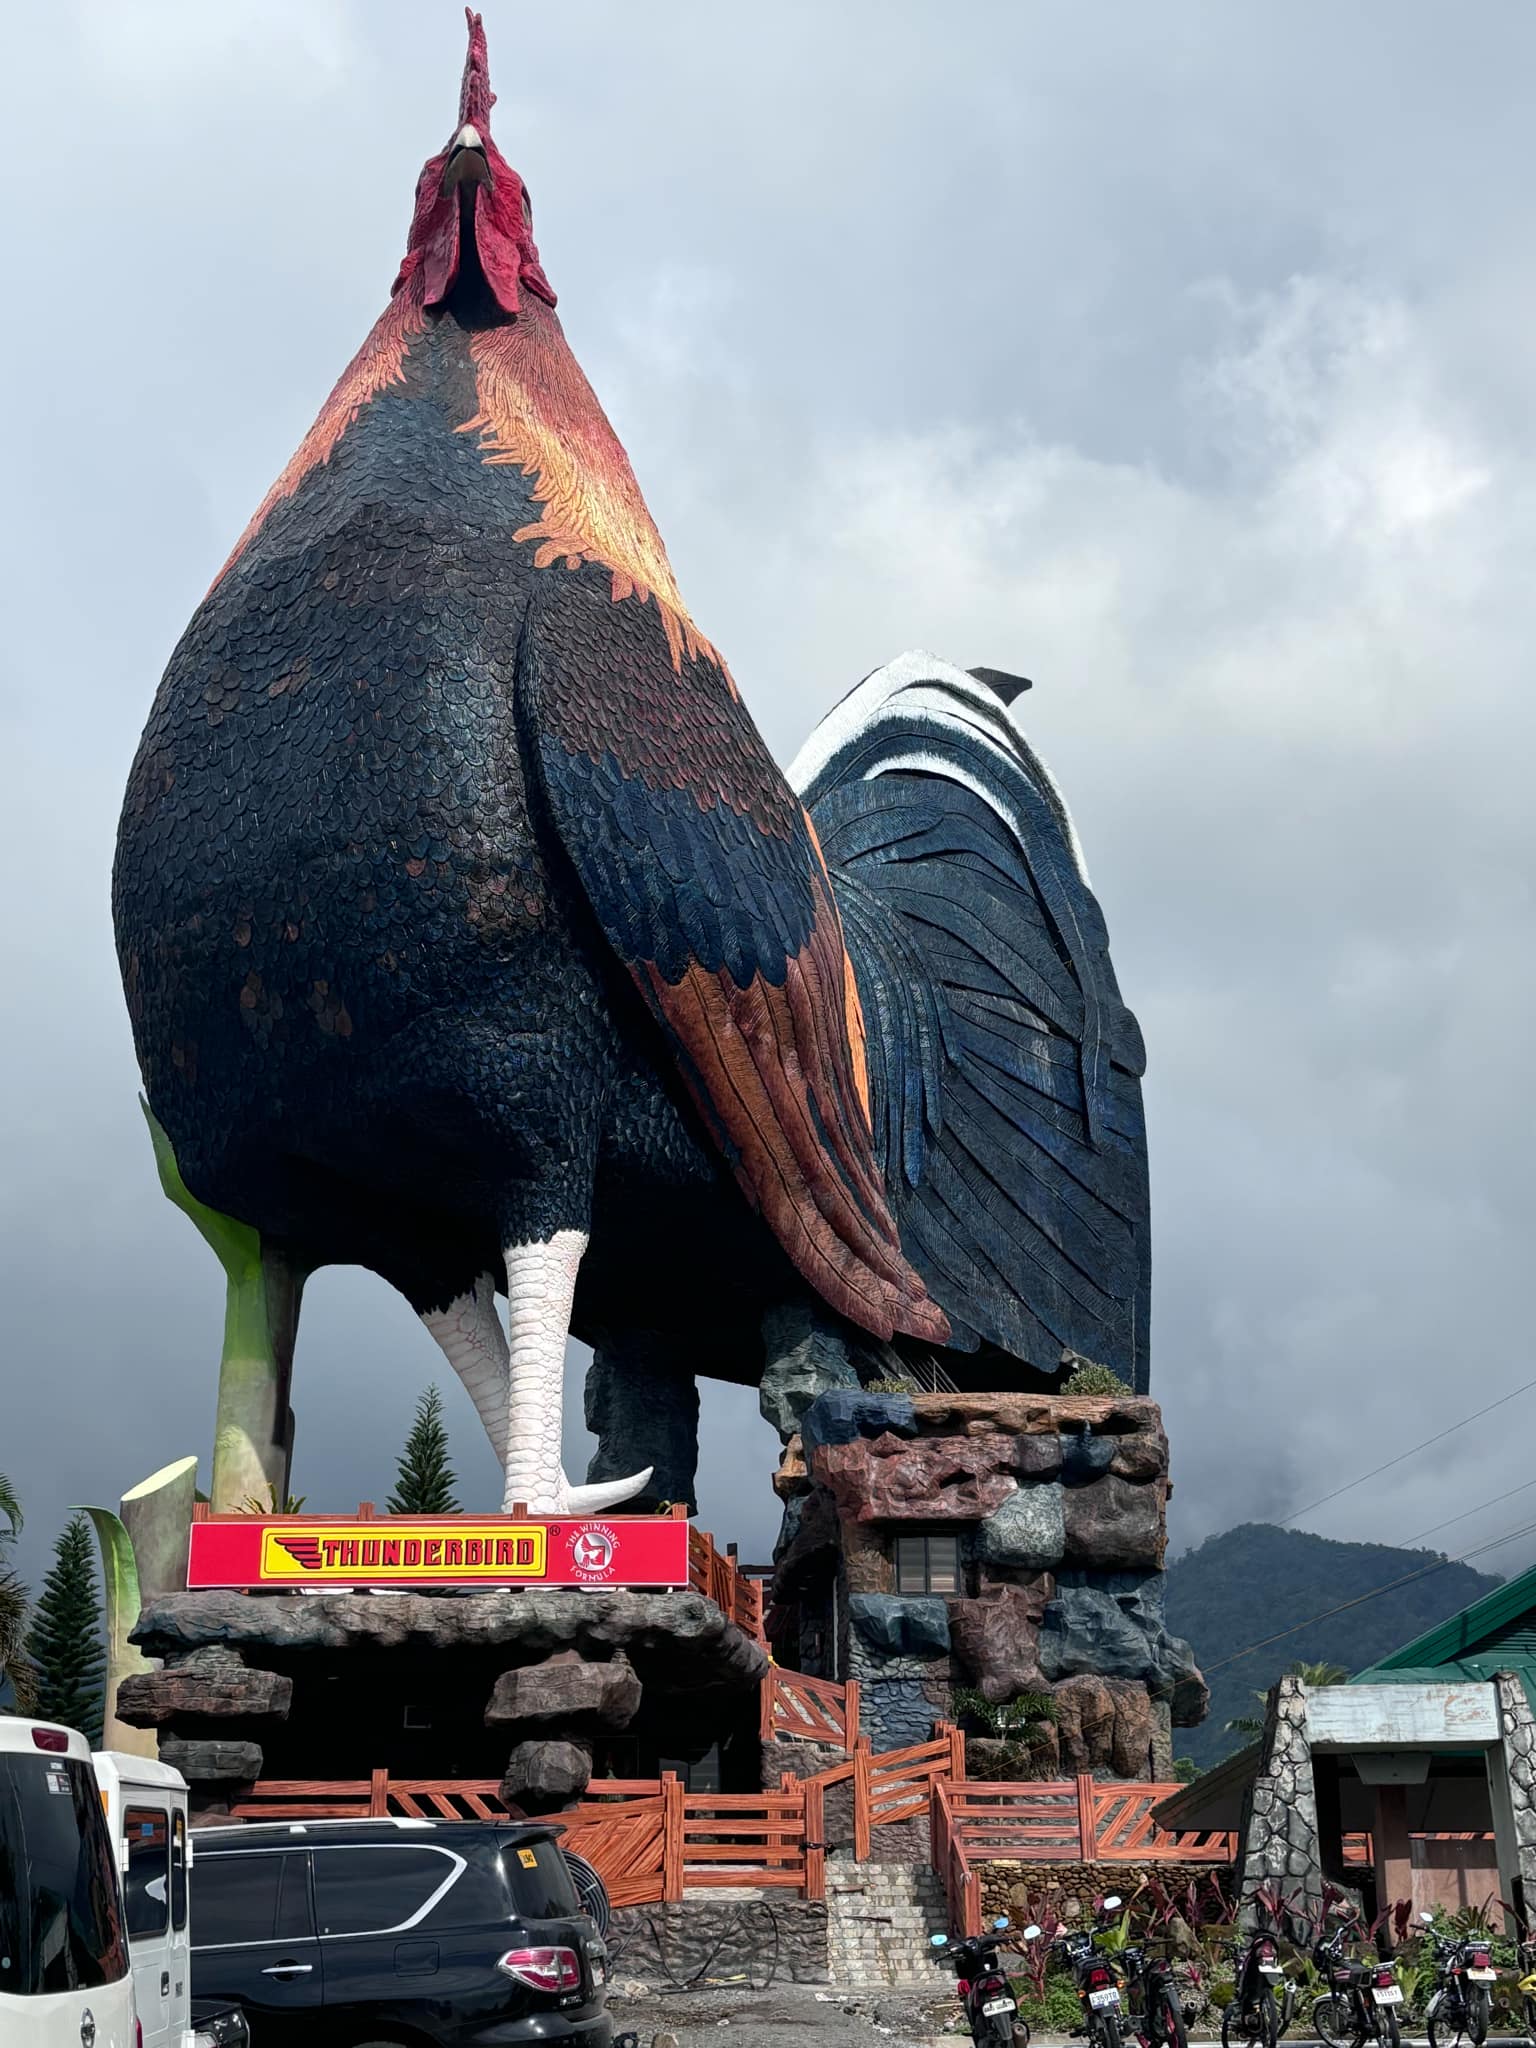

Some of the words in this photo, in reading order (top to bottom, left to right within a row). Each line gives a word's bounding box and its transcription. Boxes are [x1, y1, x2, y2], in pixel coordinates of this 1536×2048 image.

[565, 1530, 580, 1549] THE
[579, 1523, 621, 1549] WINNING
[322, 1538, 535, 1567] THUNDERBIRD
[570, 1565, 616, 1582] FORMULA
